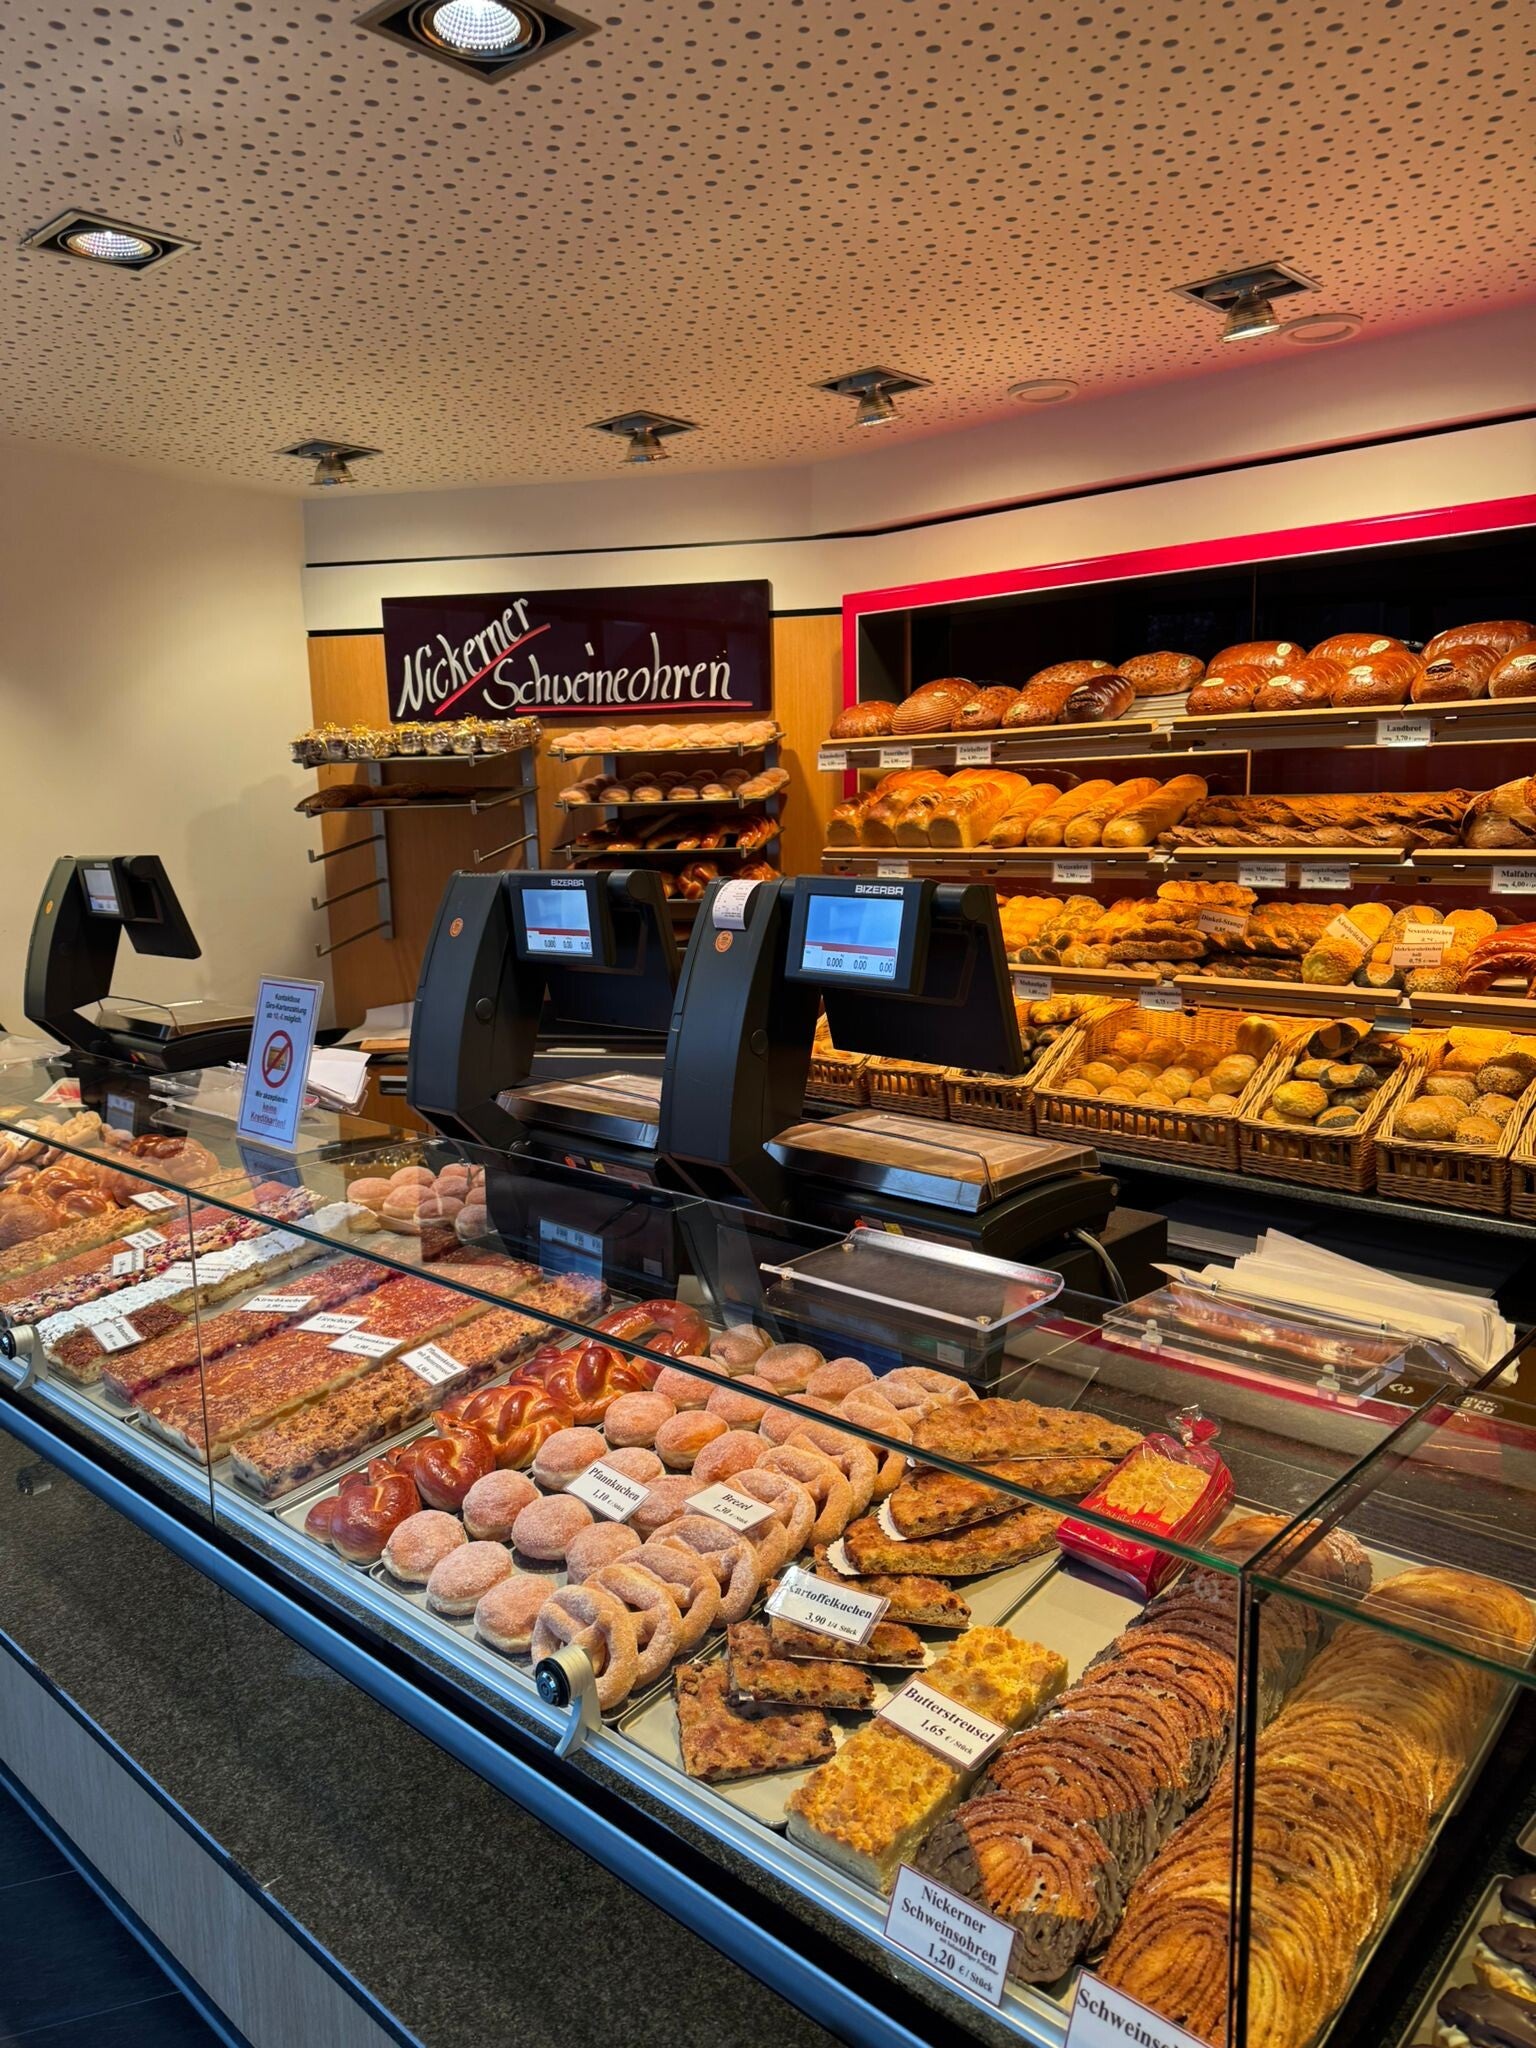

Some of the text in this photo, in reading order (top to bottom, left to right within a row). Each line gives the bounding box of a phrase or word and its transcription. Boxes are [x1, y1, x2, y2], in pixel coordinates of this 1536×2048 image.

[396, 597, 529, 718] Nickerner
[482, 631, 733, 710] Schweineohren
[1386, 724, 1422, 732] Landbrot
[550, 878, 585, 887] BIZERBA
[855, 884, 904, 896] BIZERBA
[1463, 1396, 1499, 1409] max.
[587, 1466, 641, 1502] Pfannkuchen
[592, 1489, 608, 1501] 1,10
[721, 1493, 753, 1511] Brezel
[712, 1503, 731, 1515] 1,30
[805, 1612, 827, 1625] 3,90
[838, 1625, 858, 1636] Stück
[904, 1687, 996, 1743] Butterstreusel
[920, 1719, 947, 1737] 1,65
[953, 1740, 974, 1755] Stück
[921, 1885, 987, 1934] Nickerner
[901, 1897, 998, 1967] Schweinsohren
[928, 1942, 956, 1971] 1,20
[958, 1964, 966, 1976] €
[969, 1973, 994, 1994] Stück
[1077, 1988, 1179, 2048] Schweins
